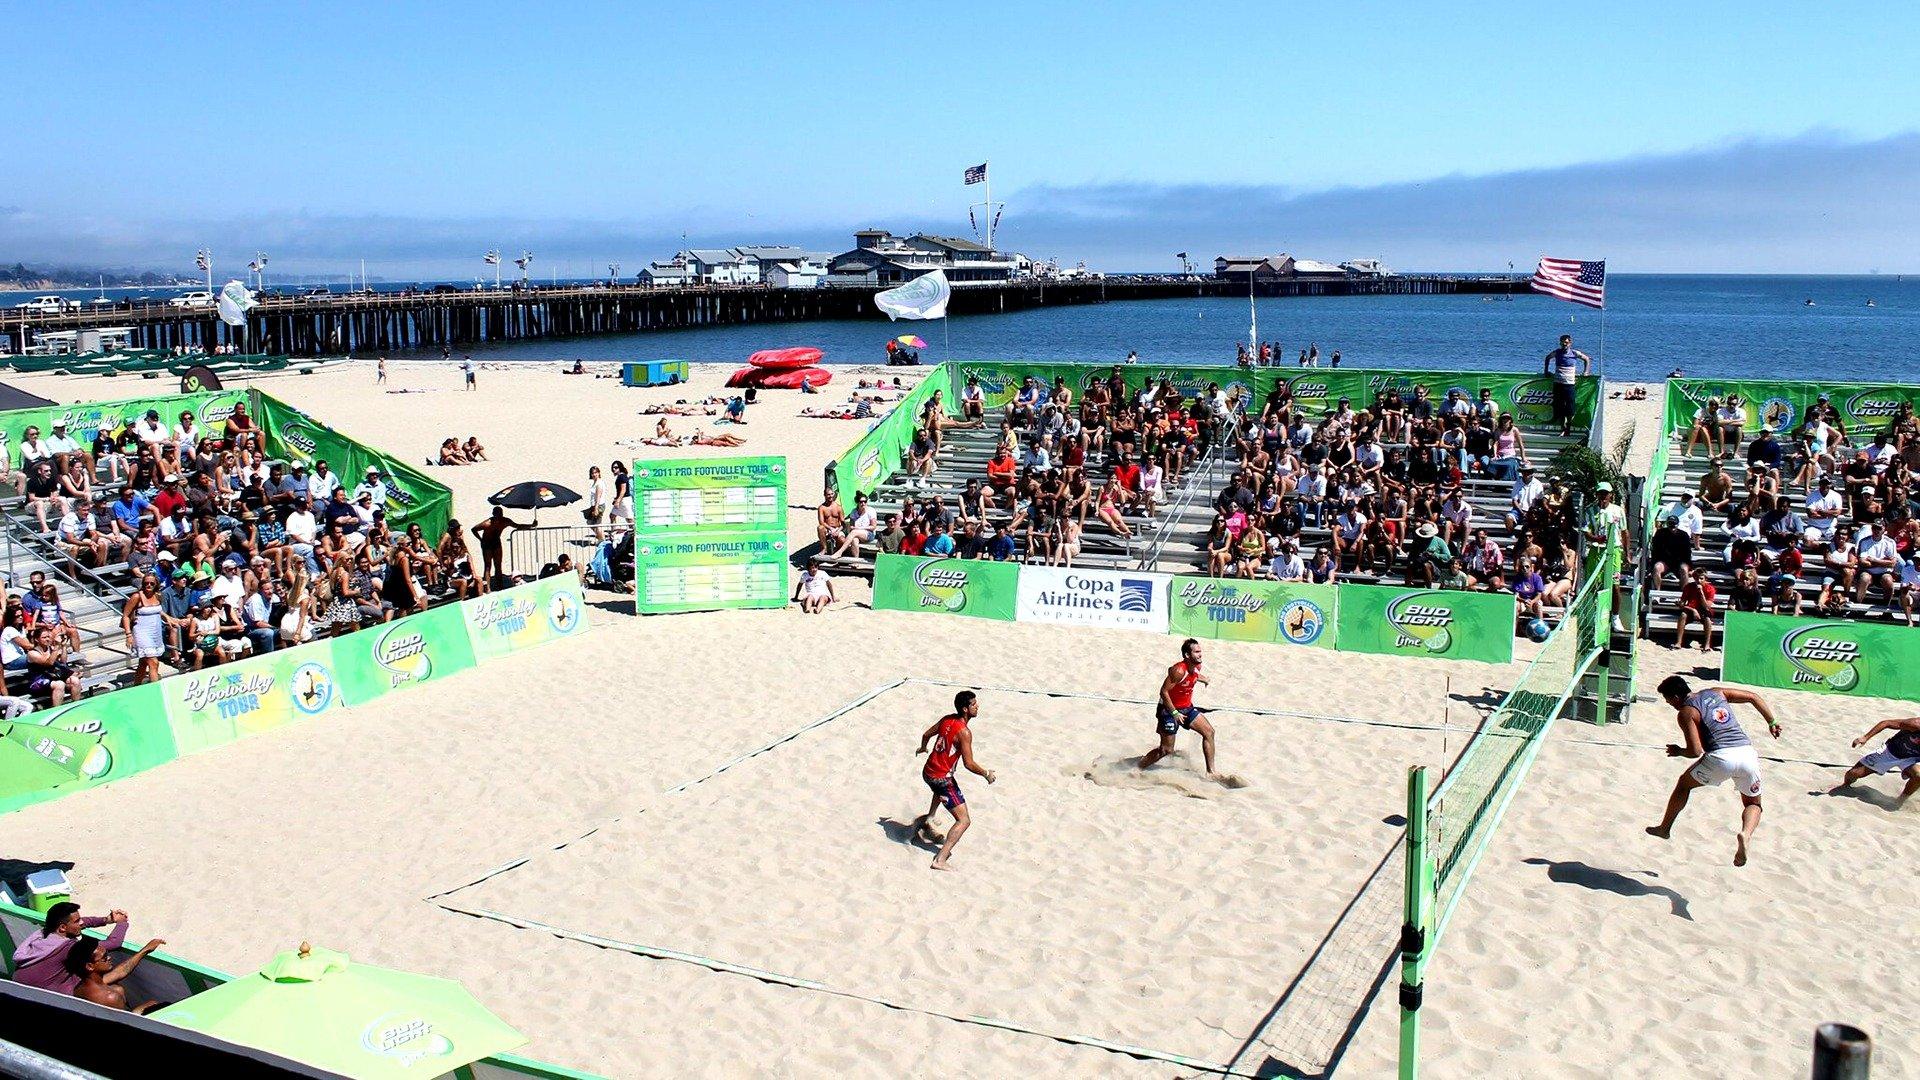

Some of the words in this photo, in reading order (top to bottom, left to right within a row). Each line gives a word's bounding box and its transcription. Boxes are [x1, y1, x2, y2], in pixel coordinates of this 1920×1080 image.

[1297, 383, 1327, 391] BUD
[653, 468, 672, 477] 2011
[675, 467, 692, 476] PRO
[694, 465, 745, 476] FOOTVOLLEY
[747, 464, 769, 474] TOUR
[654, 545, 673, 554] 2011
[676, 544, 693, 553] PRO
[695, 542, 745, 553] FOOTVOLLEY
[748, 541, 769, 551] TOUR
[919, 577, 969, 588] LIGHT
[929, 569, 968, 580] BUD
[1065, 575, 1114, 595] Copa
[1036, 591, 1113, 610] Airlines
[1207, 606, 1246, 623] TOUR
[1405, 605, 1451, 618] BUD
[497, 615, 526, 636] TOUR
[1394, 613, 1454, 627] LIGHT
[389, 633, 422, 653] BUD
[1396, 635, 1422, 648] Lime
[1803, 637, 1859, 652] BUD
[382, 641, 427, 665] LIGHT
[1791, 646, 1861, 663] LIGHT
[1792, 670, 1824, 684] Lime
[217, 693, 260, 719] TOUR
[382, 1019, 425, 1041] BUD
[382, 1024, 433, 1052] LIGHT
